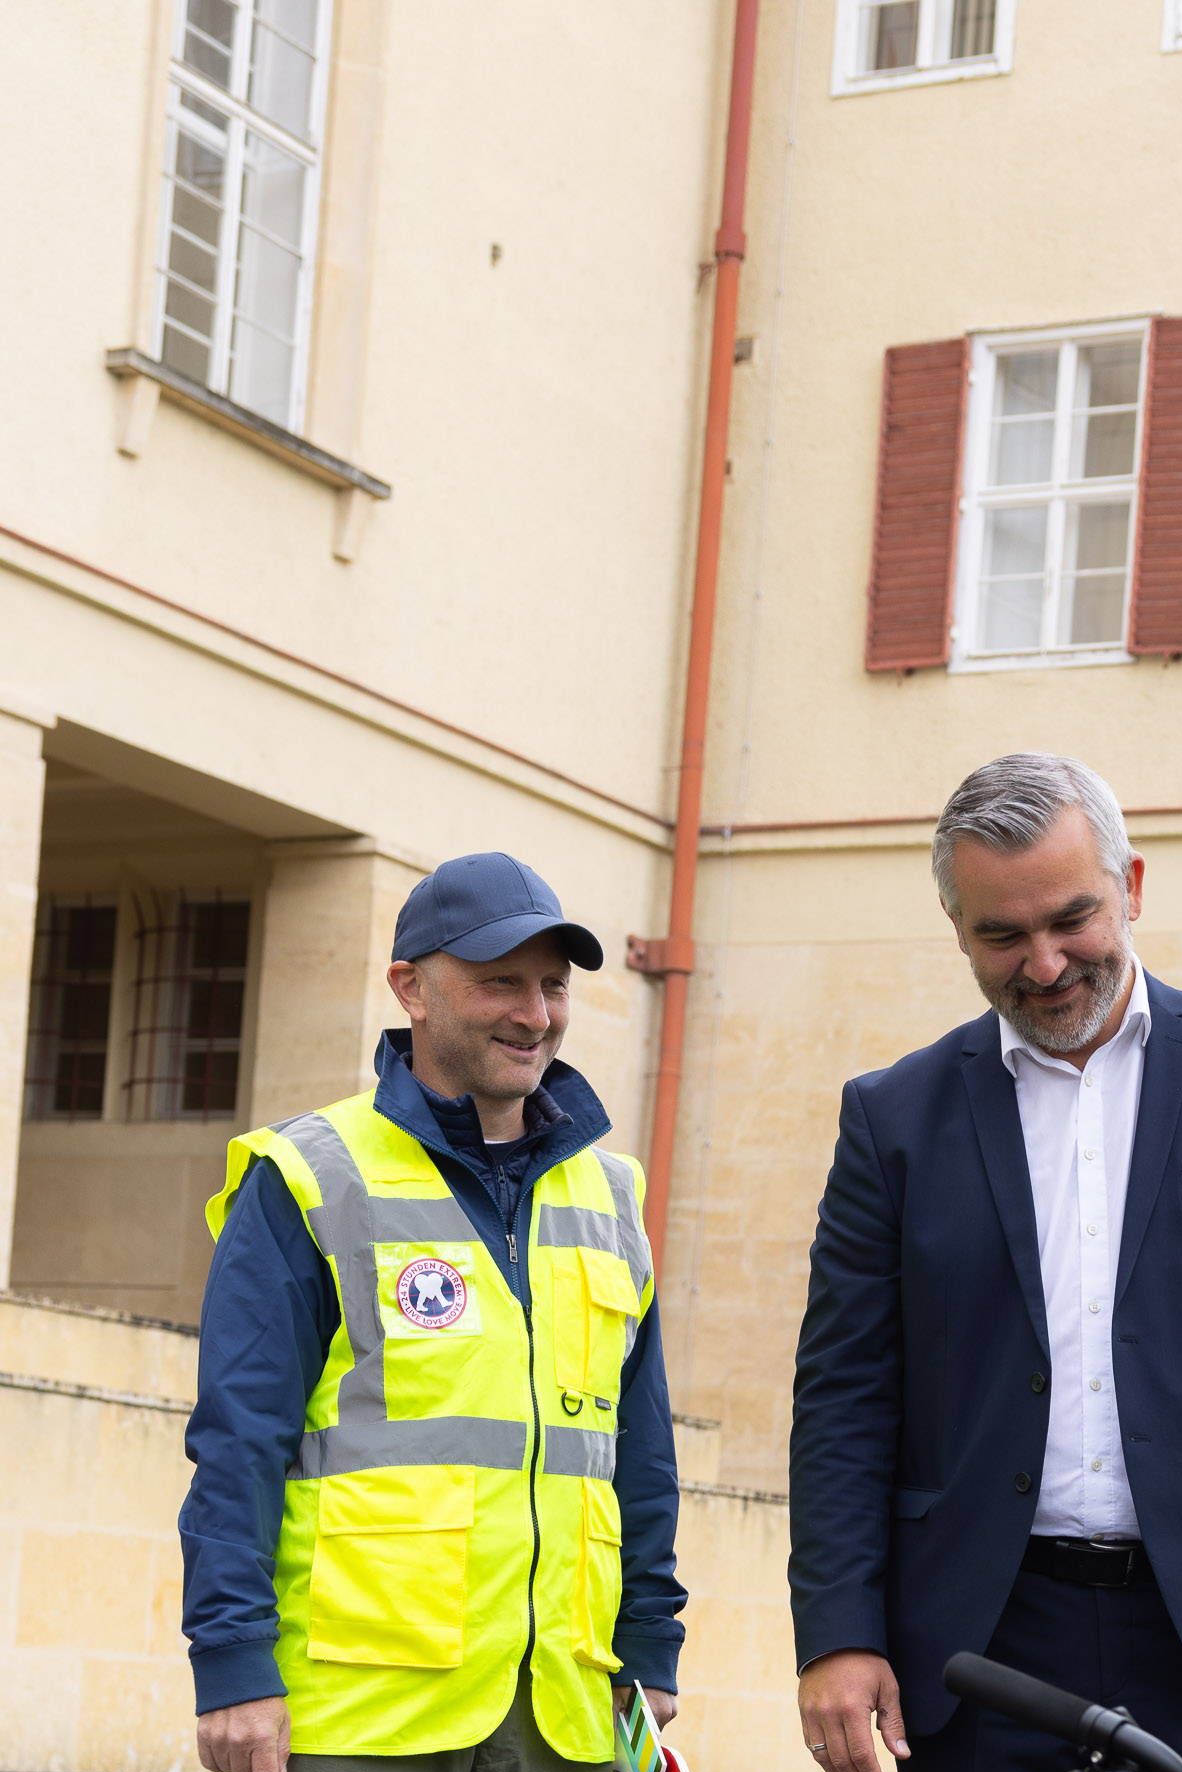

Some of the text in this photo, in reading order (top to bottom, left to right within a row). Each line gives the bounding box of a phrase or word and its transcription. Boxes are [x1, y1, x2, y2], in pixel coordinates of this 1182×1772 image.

[400, 1262, 462, 1302] 24 STUNDEN EXTREM
[405, 1306, 421, 1321] LIVE
[445, 1302, 462, 1322] MOVE
